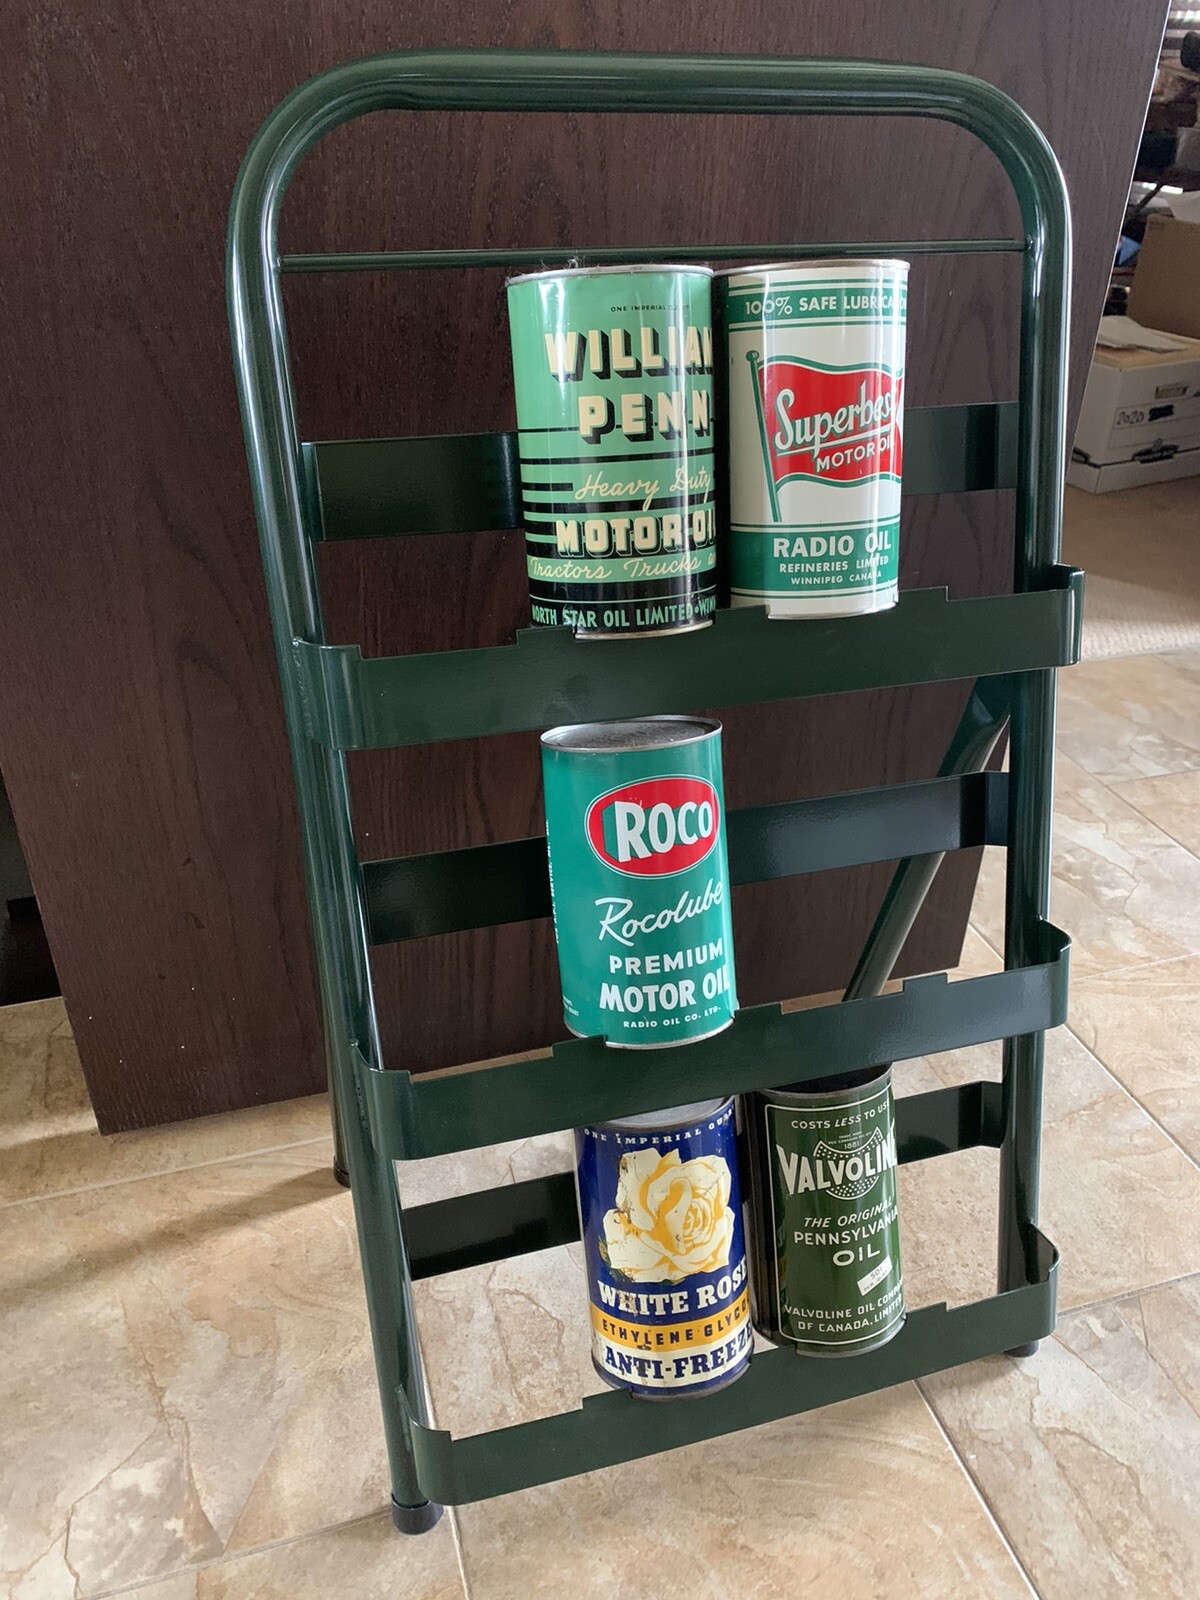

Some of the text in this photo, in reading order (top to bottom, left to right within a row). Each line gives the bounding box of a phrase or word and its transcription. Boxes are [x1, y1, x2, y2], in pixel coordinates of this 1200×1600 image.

[745, 295, 793, 316] 100%
[799, 295, 837, 311] SAFE
[578, 390, 710, 443] PENN
[816, 441, 875, 472] MOTOR
[574, 465, 712, 512] Heavy Duty
[555, 513, 687, 557] MOTOR
[773, 530, 892, 558] RADIO OIL
[529, 557, 614, 580] Tractors
[623, 554, 702, 578] Trucks
[779, 554, 889, 573] REFINERIES LIMITED
[791, 576, 843, 585] WINNIPEG
[531, 604, 557, 625] NORTH
[562, 608, 598, 628] STAR
[603, 609, 630, 628] OIL
[636, 603, 694, 626] LIMITED
[612, 800, 714, 863] ROCO
[594, 877, 723, 947] Rocolube
[609, 937, 723, 976] PREMIUM
[599, 979, 697, 1013] MOTOR
[702, 963, 731, 1000] OIL
[623, 1006, 722, 1028] RADIO OIL CO. LTD.
[791, 1120, 831, 1129] COSTS
[834, 1115, 862, 1127] LESS
[863, 1109, 876, 1120] TO
[584, 1128, 607, 1141] ONE
[616, 1129, 702, 1145] IMPERIAL
[794, 1205, 898, 1246] PENNSYLVANIA
[804, 1195, 893, 1228] THE ORIGINAL
[832, 1243, 881, 1267] OIL
[597, 1280, 689, 1316] WHITE
[784, 1304, 852, 1319] VALVOLINE
[857, 1302, 876, 1315] OIL
[602, 1319, 693, 1346] ETHYLENE
[797, 1320, 813, 1331] OF
[605, 1319, 752, 1380] ANTI-FREEZE
